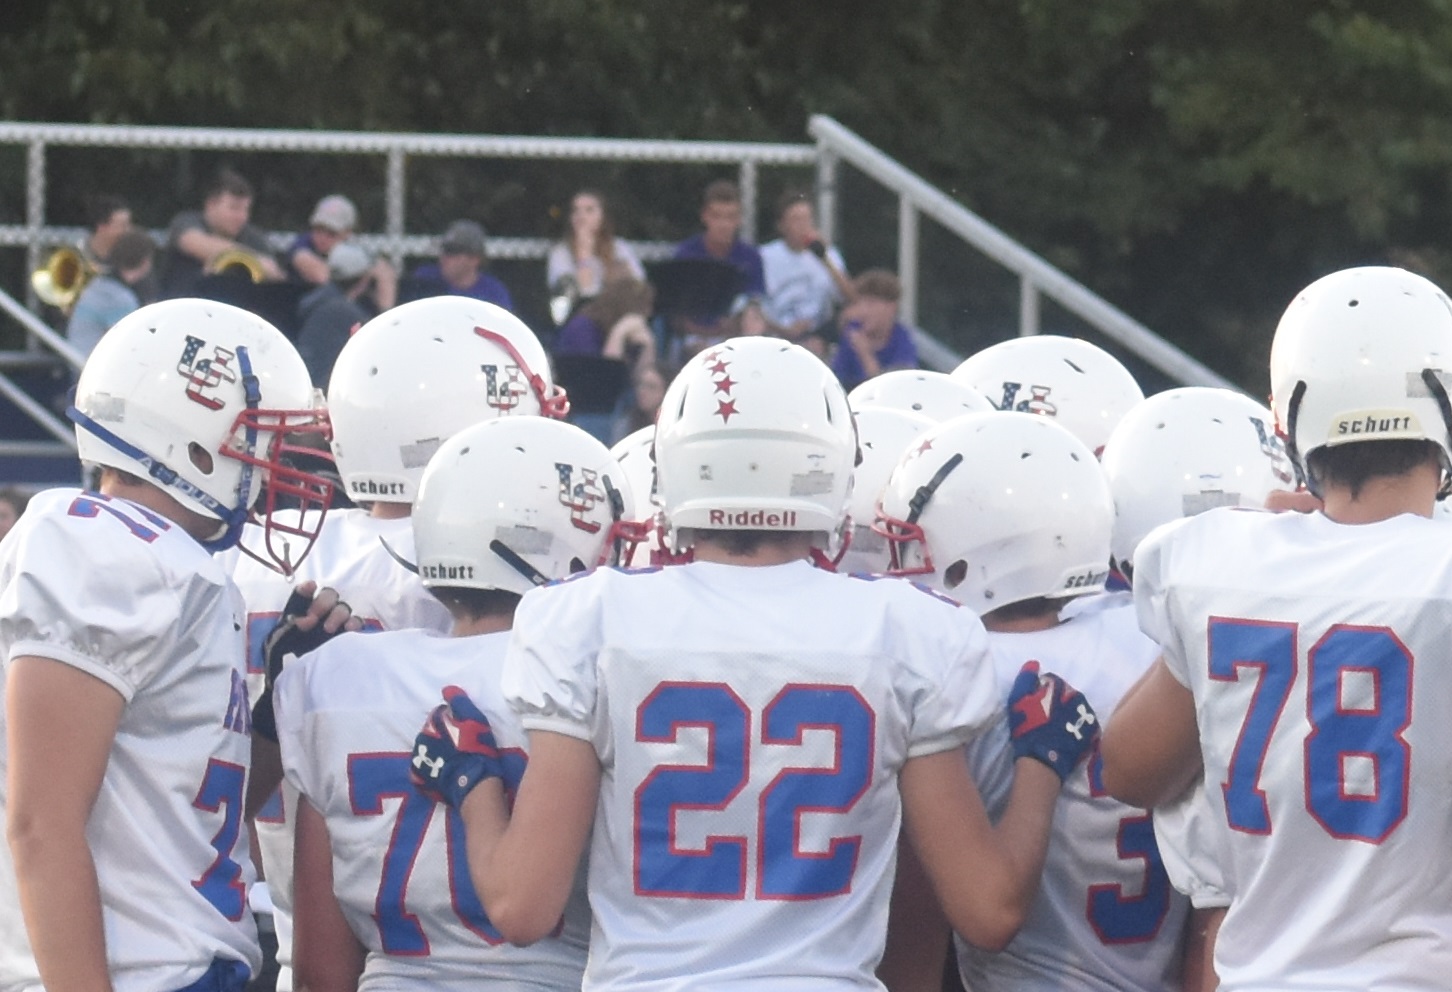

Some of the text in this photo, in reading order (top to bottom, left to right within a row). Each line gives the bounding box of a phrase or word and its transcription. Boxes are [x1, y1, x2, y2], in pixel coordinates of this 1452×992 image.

[1337, 416, 1411, 435] schutt
[350, 480, 406, 496] schutt
[709, 508, 798, 528] Riddell
[421, 563, 475, 580] schutt
[1207, 615, 1415, 846] 78
[632, 680, 877, 902] 22
